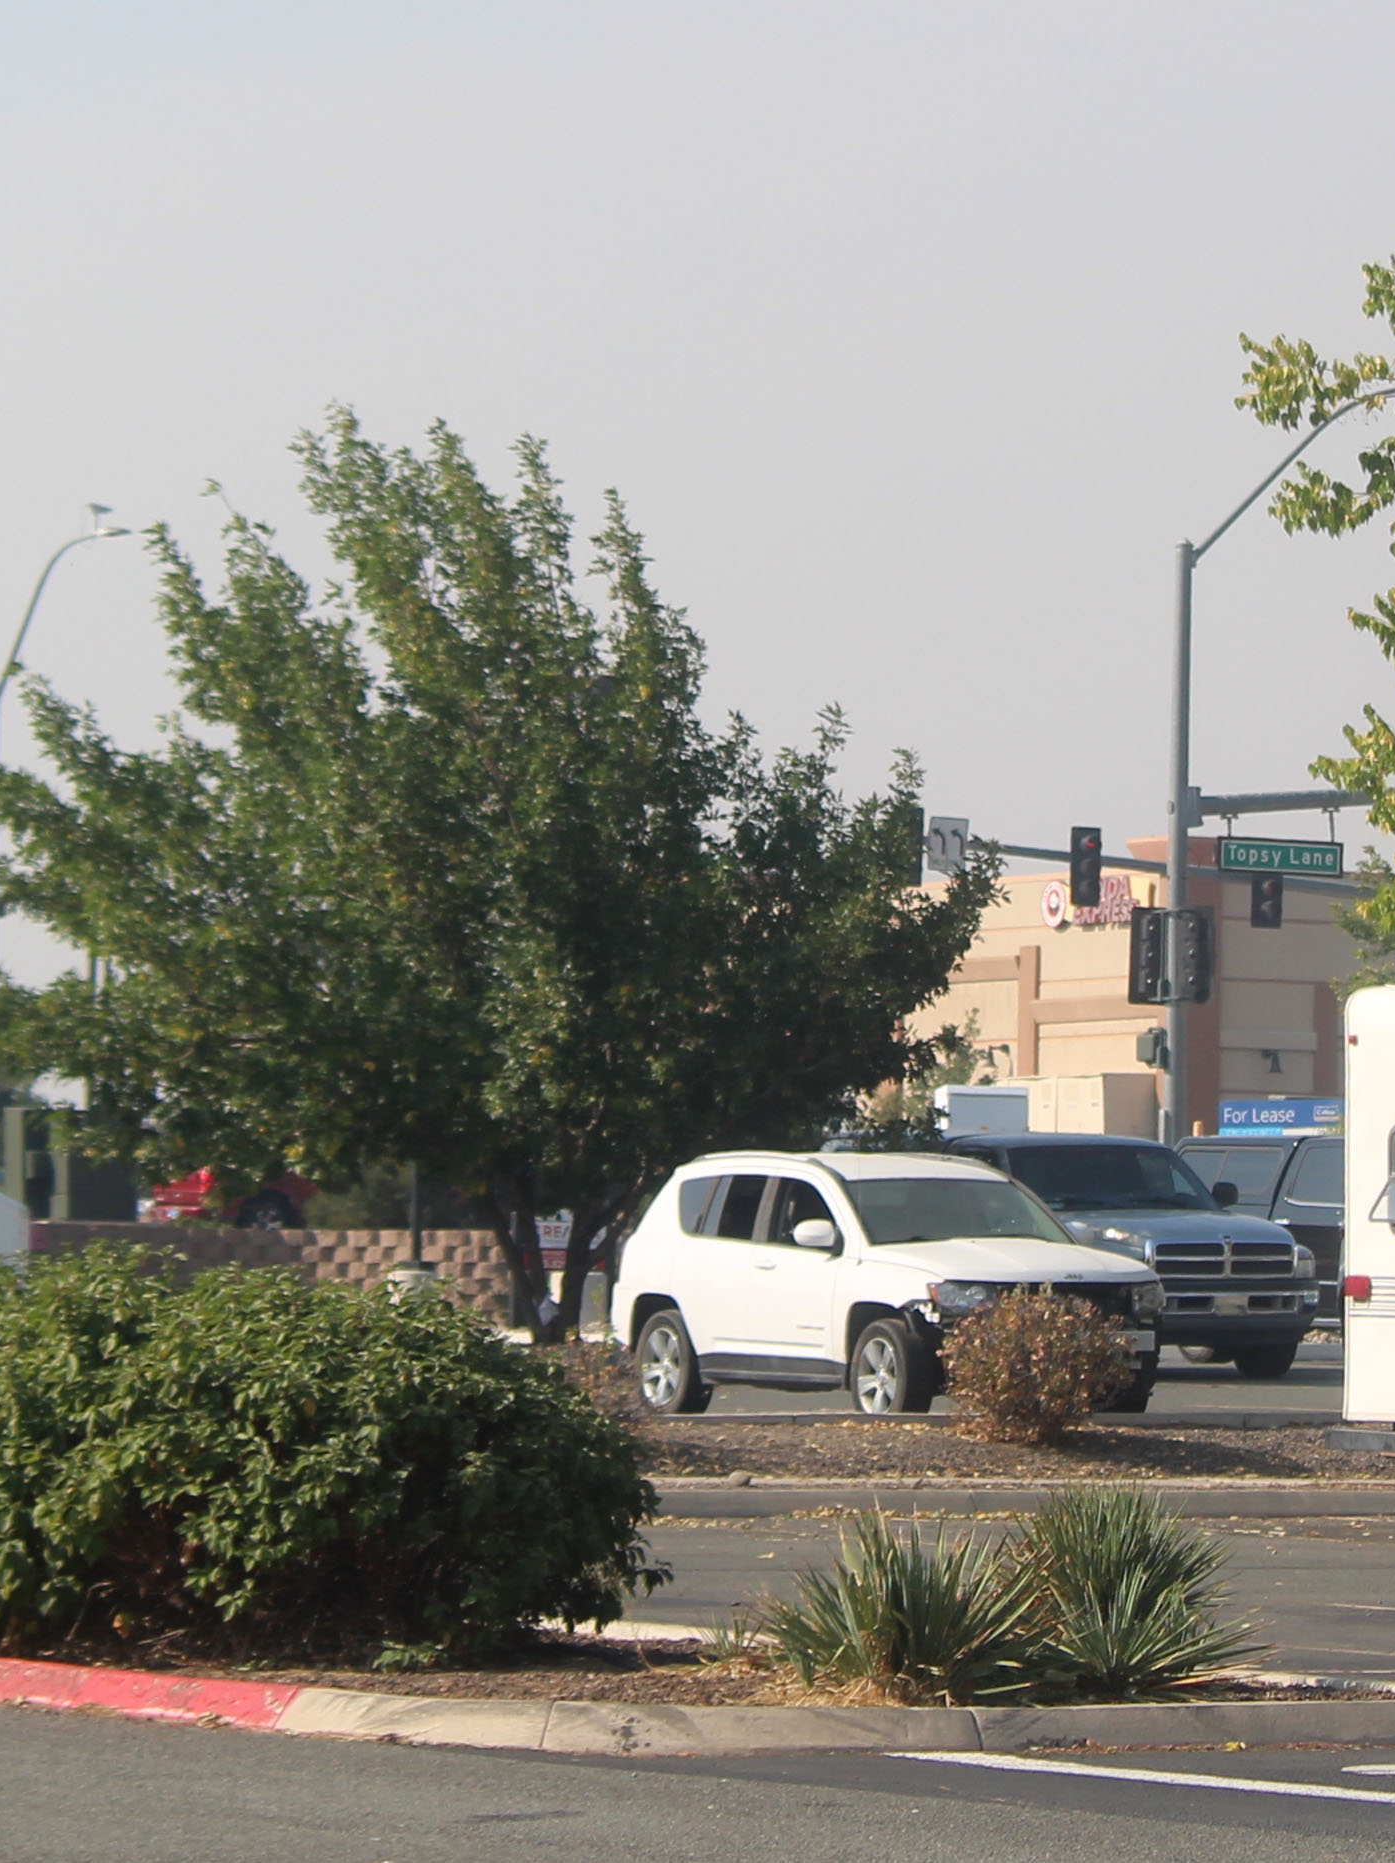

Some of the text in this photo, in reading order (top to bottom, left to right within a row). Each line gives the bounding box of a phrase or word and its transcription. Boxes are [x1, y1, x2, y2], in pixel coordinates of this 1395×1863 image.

[1228, 844, 1335, 866] Topsy Lane
[1223, 1107, 1248, 1124] For
[1252, 1108, 1295, 1124] Lease
